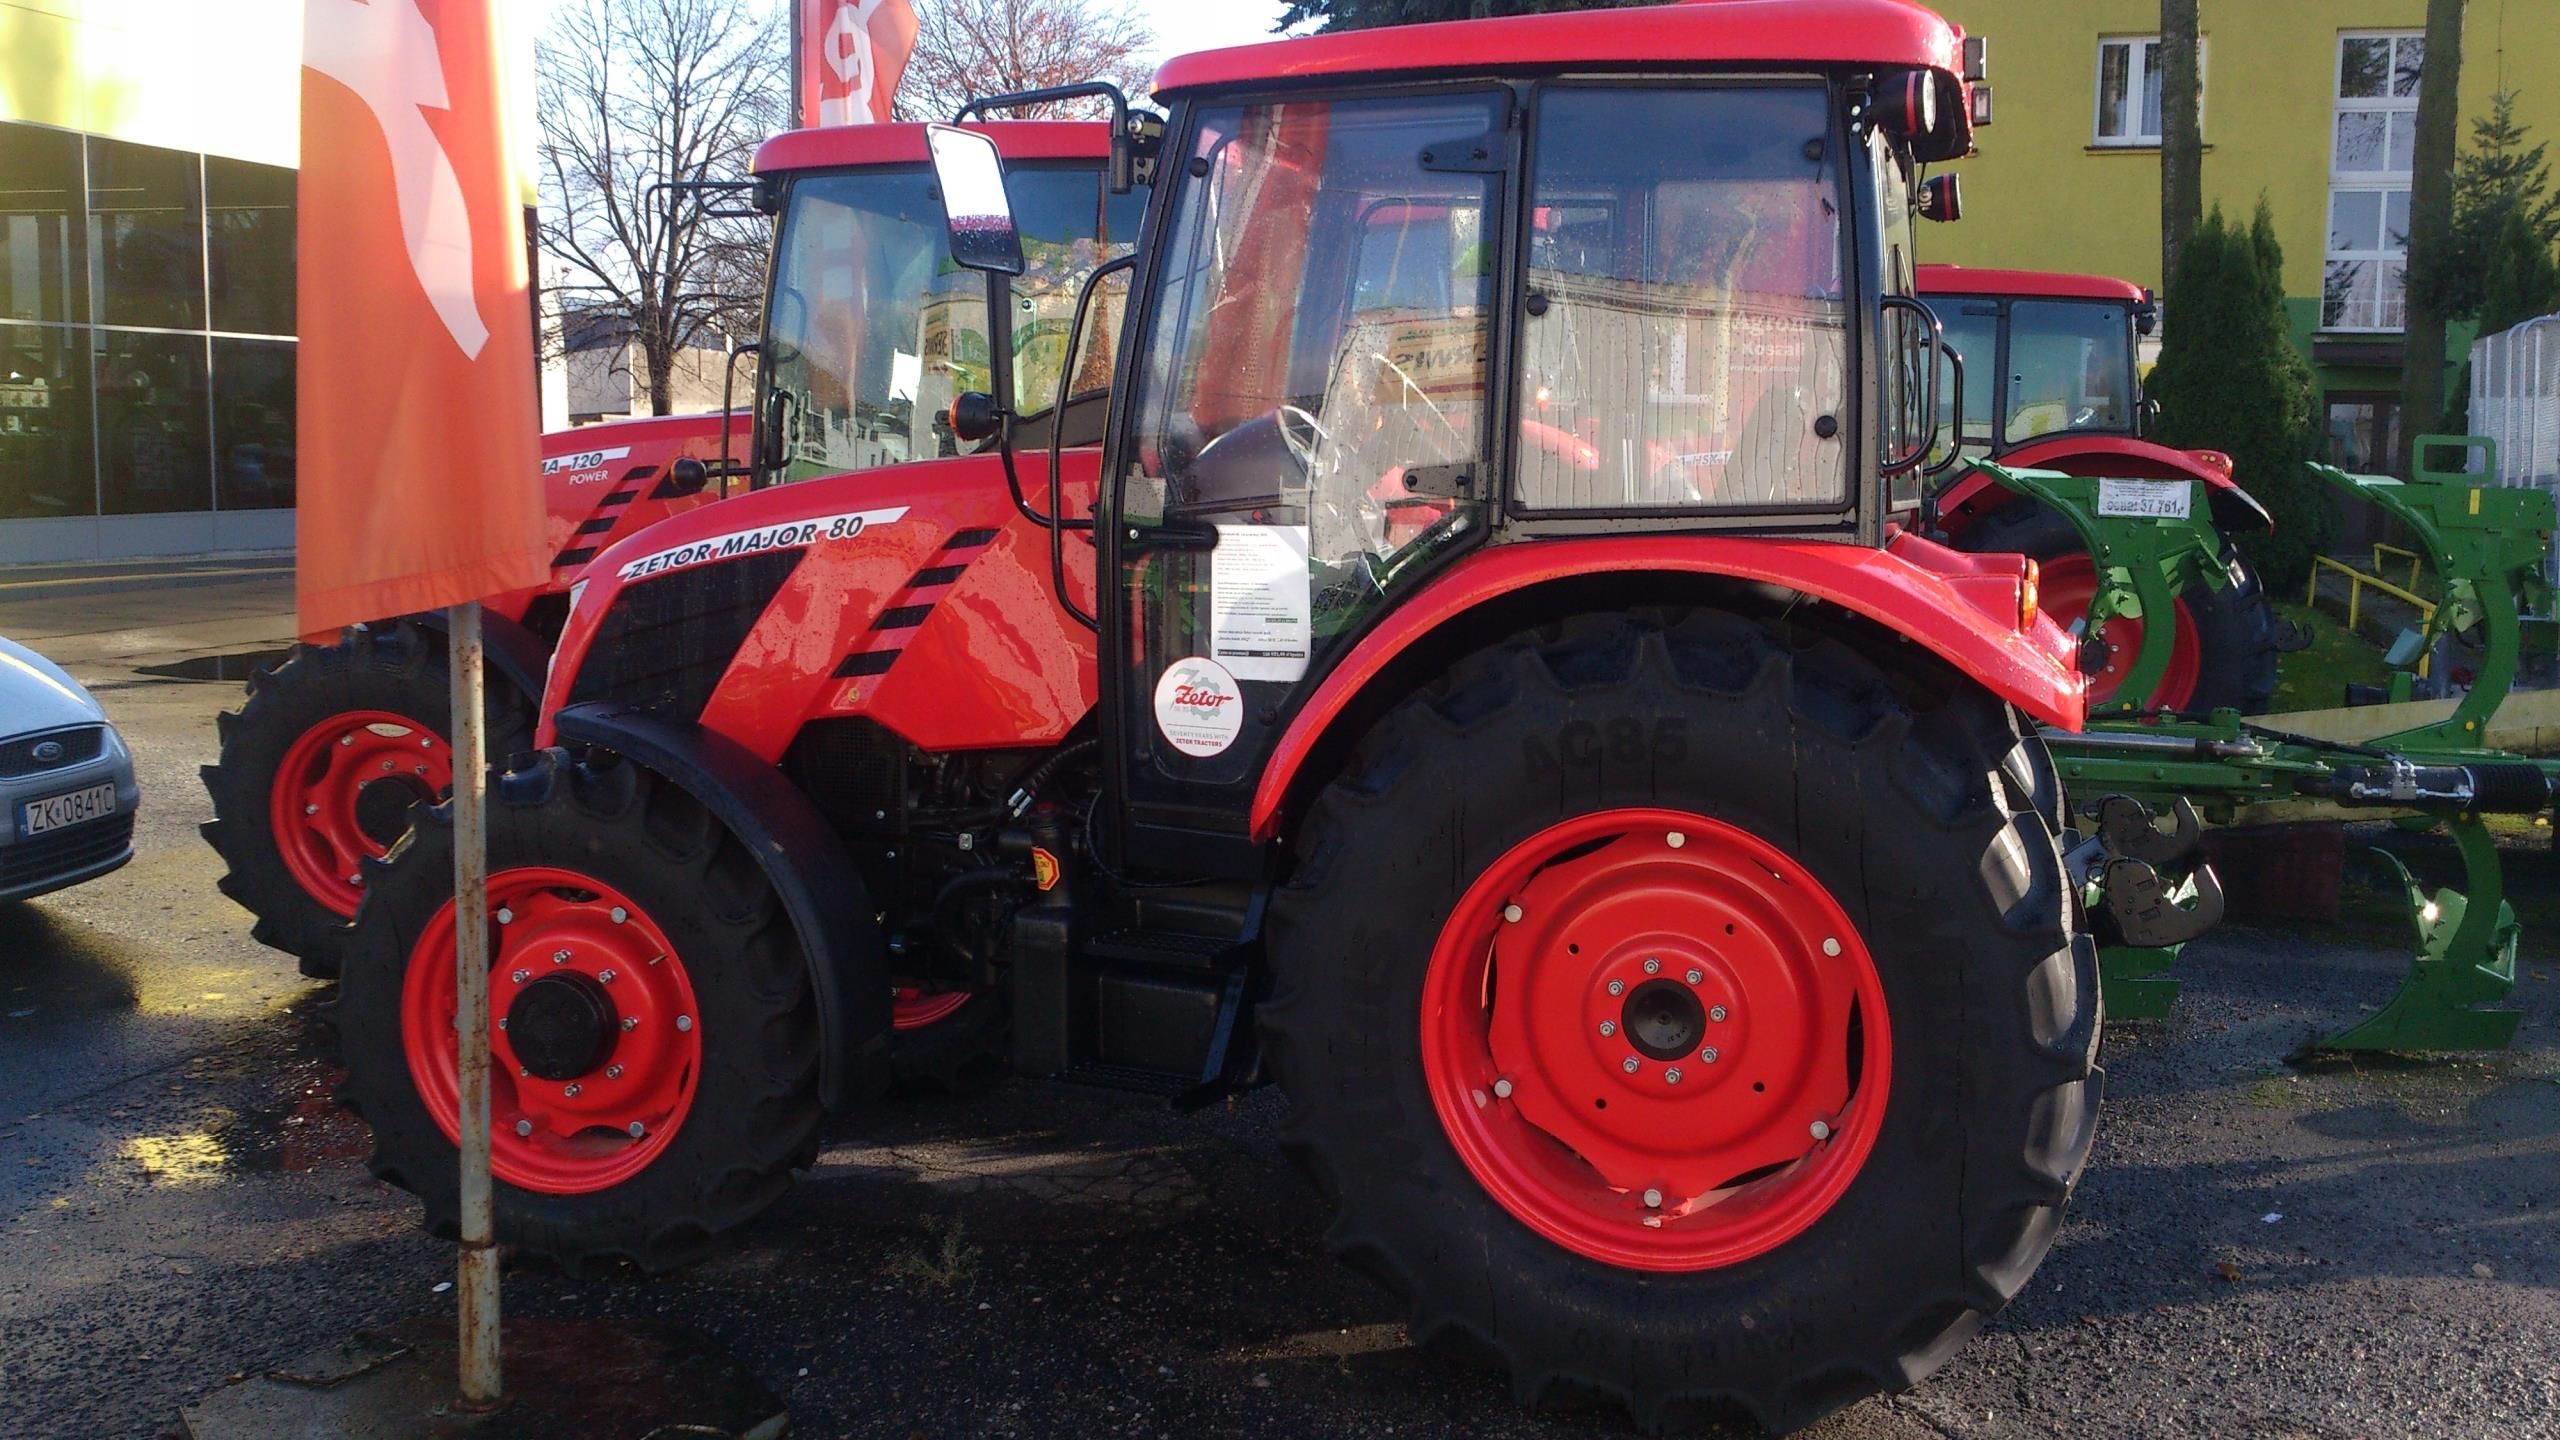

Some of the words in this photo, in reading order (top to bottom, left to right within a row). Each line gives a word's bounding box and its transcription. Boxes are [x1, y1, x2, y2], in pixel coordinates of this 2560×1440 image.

[570, 452, 604, 470] 120
[569, 470, 609, 485] POWER
[627, 544, 712, 580] ZETOR
[718, 523, 818, 557] MAJOR
[828, 516, 864, 539] 80
[1175, 684, 1234, 707] Zetor
[30, 800, 58, 832] ZK
